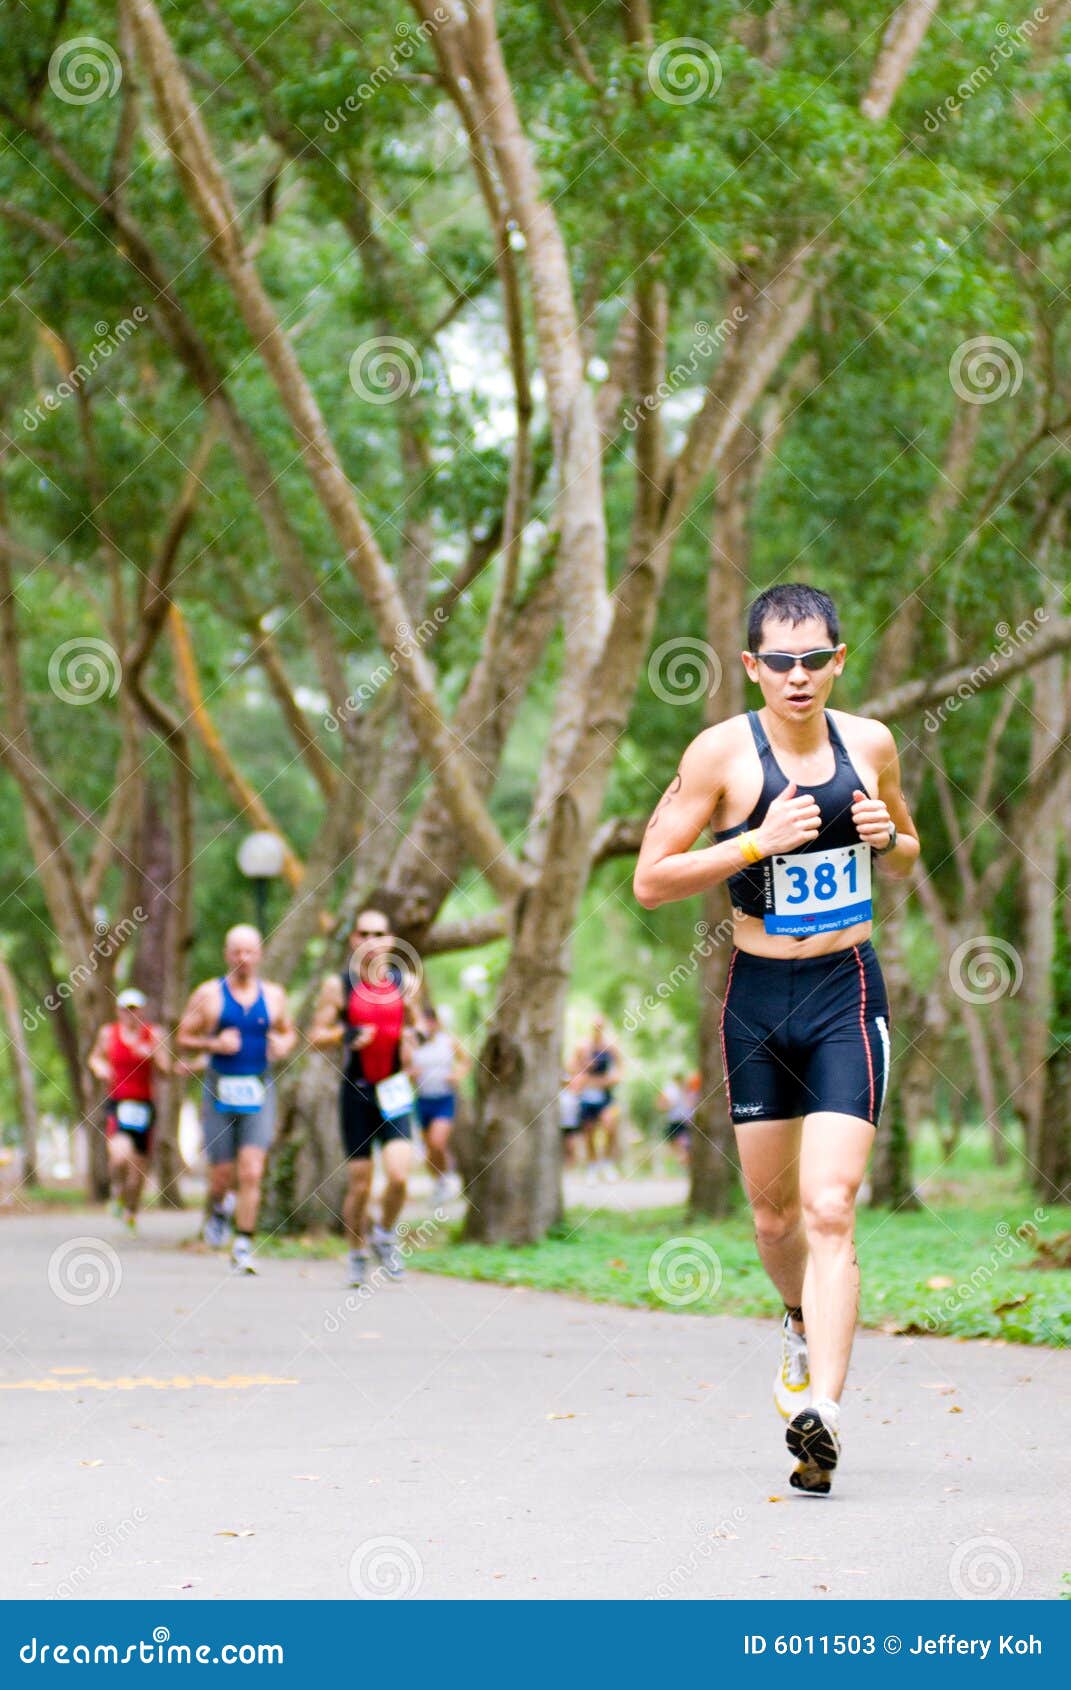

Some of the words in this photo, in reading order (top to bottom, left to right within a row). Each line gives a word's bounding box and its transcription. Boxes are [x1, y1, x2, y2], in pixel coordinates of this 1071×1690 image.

[763, 866, 773, 909] TRIATHLON
[785, 857, 859, 905] 381
[776, 925, 817, 934] SINGAPORE
[818, 920, 842, 931] SPRINT
